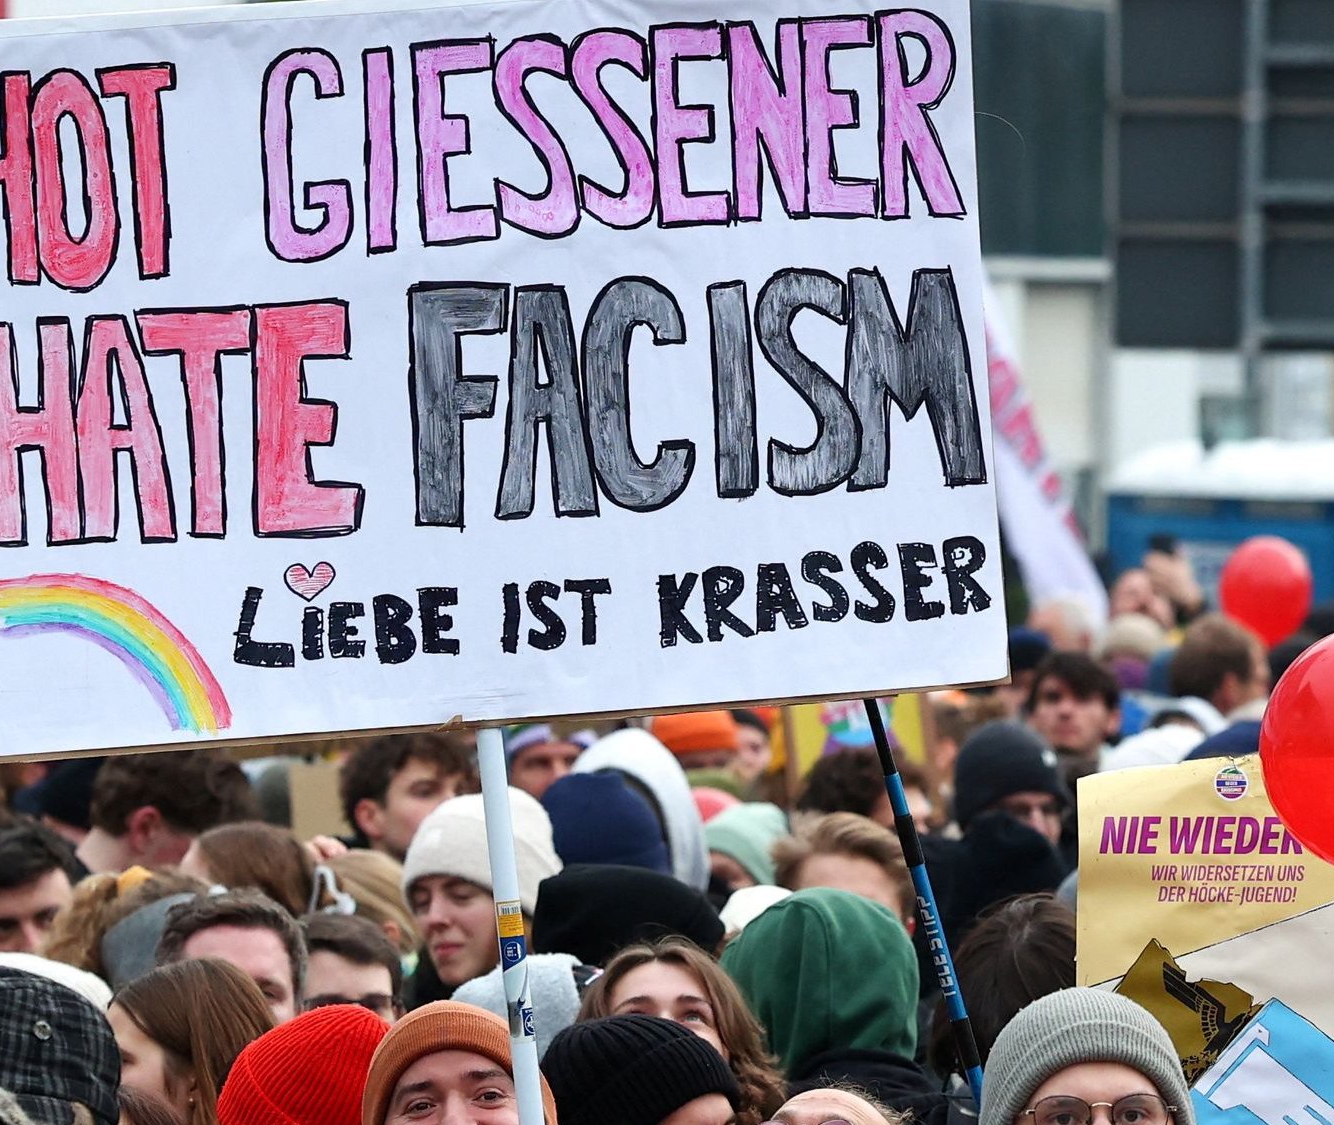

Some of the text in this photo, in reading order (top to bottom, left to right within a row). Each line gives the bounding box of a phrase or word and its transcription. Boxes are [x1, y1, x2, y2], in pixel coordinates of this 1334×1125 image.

[262, 9, 968, 264] GIESSENER
[407, 266, 988, 531] FACISM
[501, 577, 612, 655] IST
[657, 535, 993, 650] KRASSER
[1099, 816, 1161, 854] NIE
[1151, 865, 1305, 882] WIR WIDERSETZEN UNS
[1158, 882, 1297, 905] DER HÖCKE-JUGEND!
[916, 895, 958, 1000] TELE STIPP
